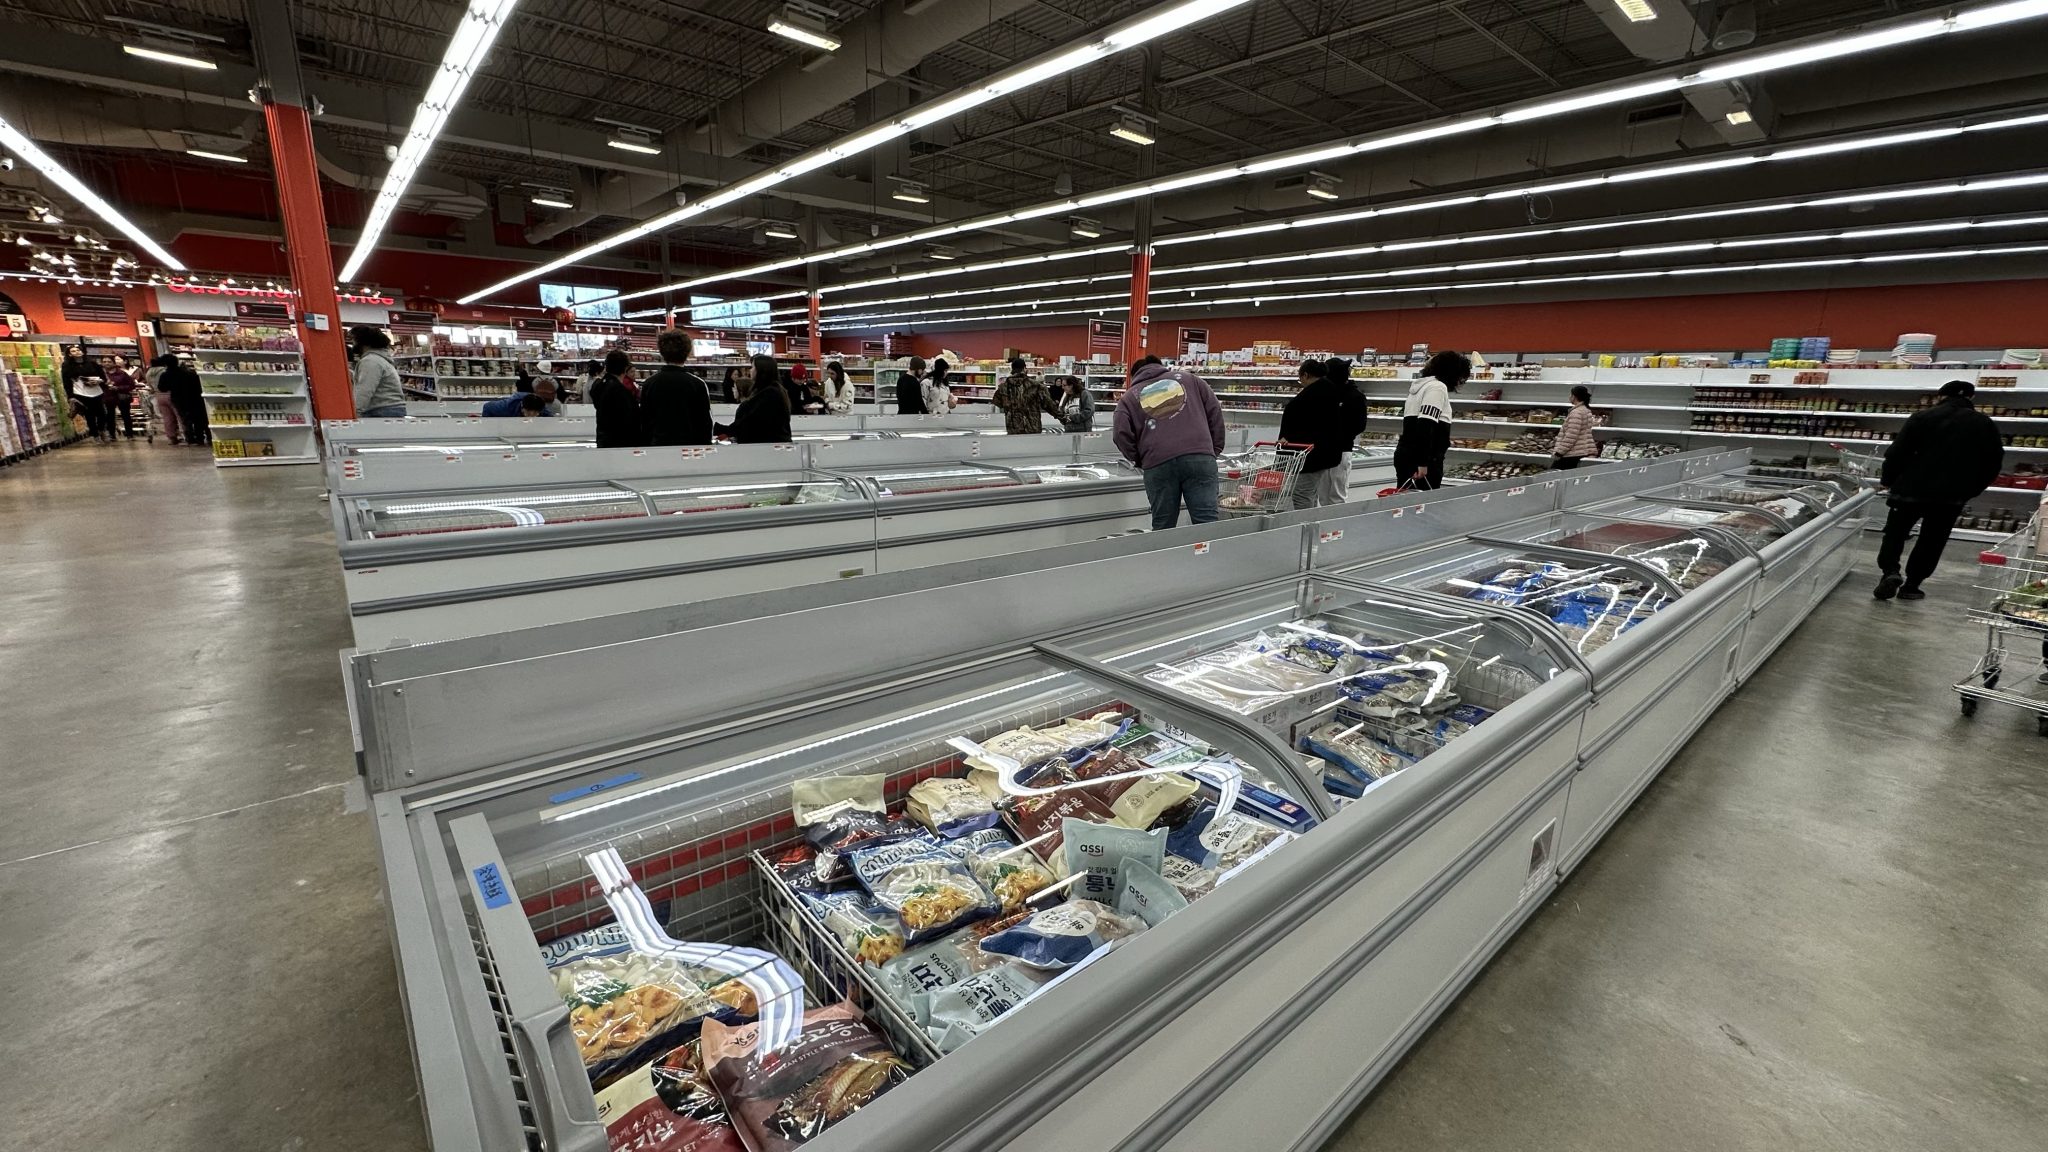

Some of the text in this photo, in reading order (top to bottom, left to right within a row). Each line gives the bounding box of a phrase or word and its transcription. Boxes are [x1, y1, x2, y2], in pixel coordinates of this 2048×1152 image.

[66, 296, 76, 305] 2
[240, 304, 248, 313] 3
[12, 318, 21, 328] 5
[141, 324, 150, 334] 3
[1420, 404, 1442, 419] UM
[1037, 796, 1085, 832] 낙지볶음
[1079, 844, 1104, 857] assi
[1128, 884, 1149, 906] assi
[541, 932, 594, 966] QUID
